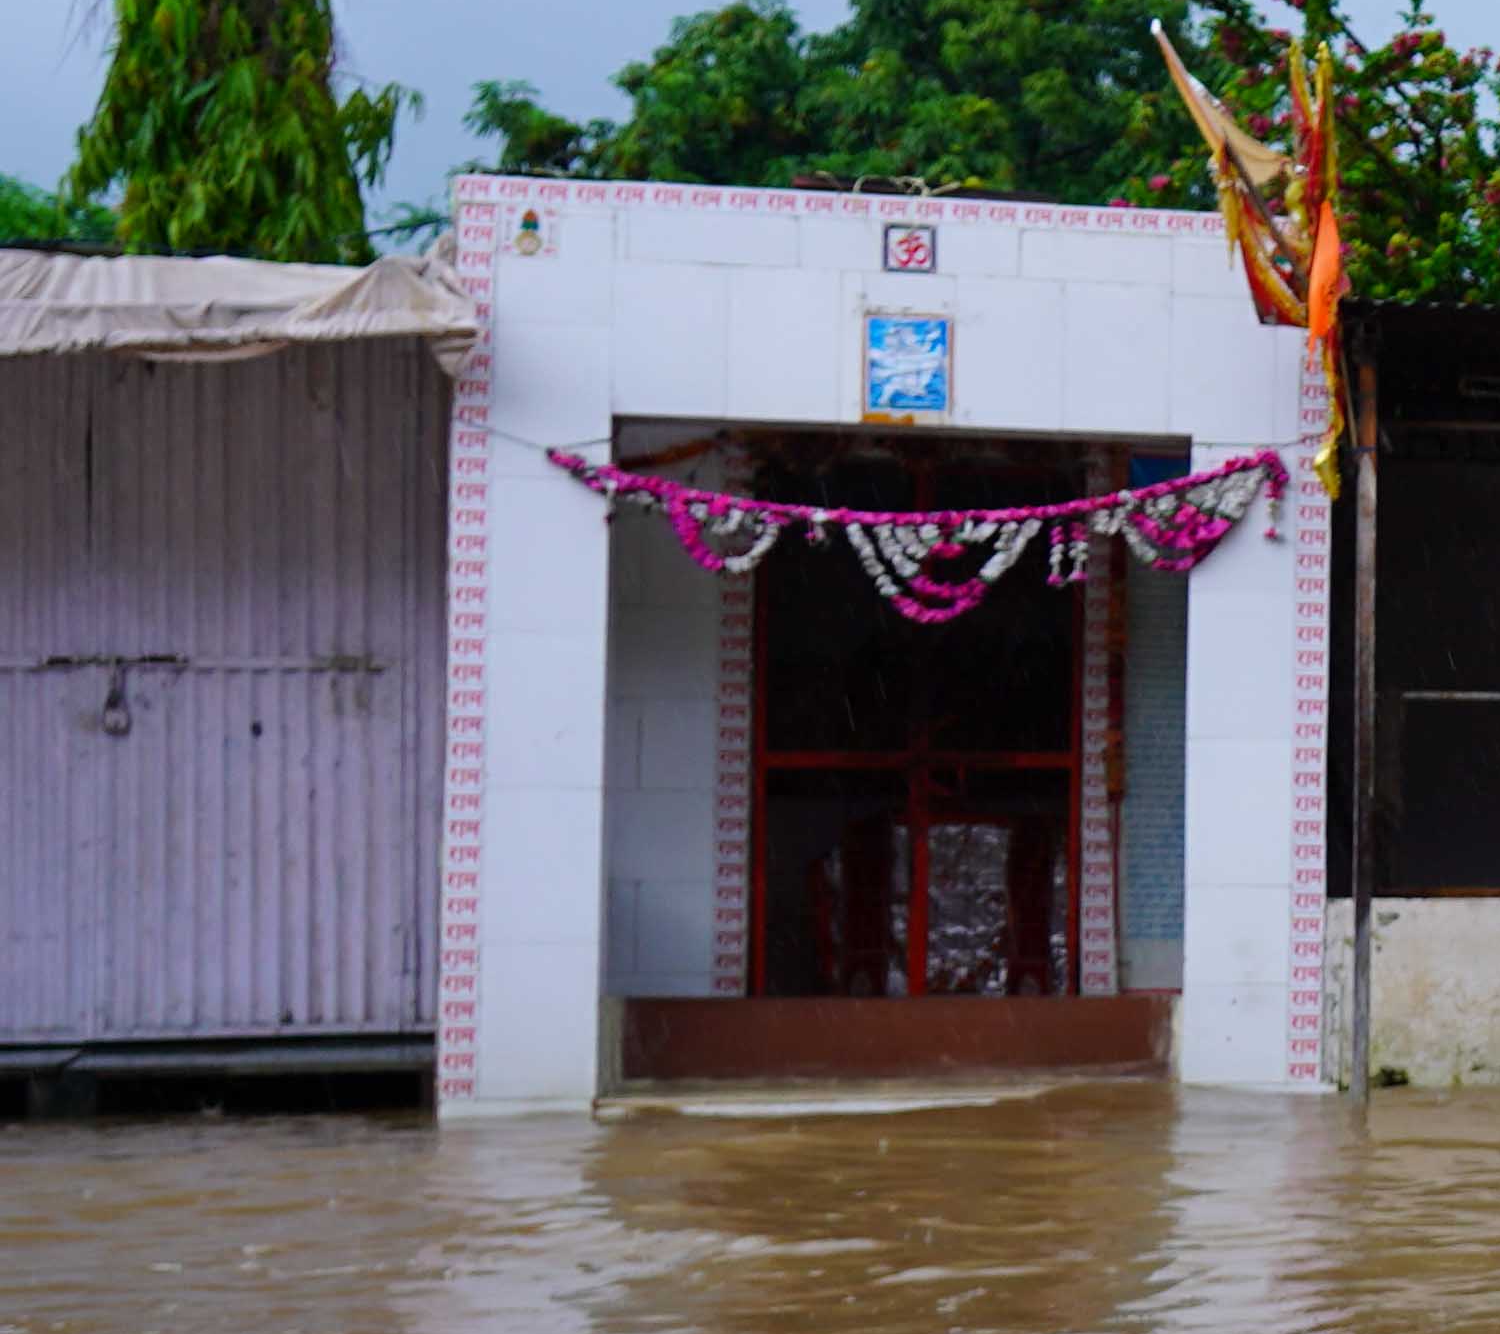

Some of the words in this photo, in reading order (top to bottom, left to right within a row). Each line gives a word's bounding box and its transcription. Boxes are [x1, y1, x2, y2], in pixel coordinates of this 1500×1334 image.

[465, 203, 492, 219] राम
[464, 224, 492, 241] राम
[463, 250, 490, 267] राम
[894, 233, 929, 267] ॐ
[459, 379, 487, 395] राम
[458, 405, 487, 422] राम
[458, 430, 486, 449] राम
[456, 456, 486, 475] राम
[457, 482, 486, 499] राम
[455, 508, 486, 526] राम
[1300, 505, 1326, 521] राम
[456, 534, 486, 553] राम
[1300, 528, 1325, 545] राम
[455, 559, 484, 577] राम
[1299, 553, 1324, 569] राम
[456, 585, 485, 602] राम
[1297, 578, 1325, 593] राम
[1298, 602, 1325, 616] राम
[454, 612, 484, 629] राम
[1296, 626, 1324, 642] राम
[454, 638, 483, 656] राम
[1297, 650, 1324, 666] राम
[453, 664, 482, 680] राम
[1296, 674, 1324, 689] राम
[453, 689, 483, 706] राम
[1298, 698, 1324, 715] राम
[453, 715, 481, 733] राम
[1295, 722, 1321, 738] राम
[453, 741, 481, 758] राम
[1295, 746, 1320, 763] राम
[450, 767, 480, 785] राम
[1294, 772, 1320, 786] राम
[451, 793, 480, 812] राम
[1295, 795, 1323, 811] राम
[449, 819, 480, 837] राम
[1293, 820, 1321, 836] राम
[449, 845, 480, 863] राम
[1294, 844, 1323, 859] राम
[448, 870, 477, 889] राम
[1295, 868, 1323, 884] राम
[448, 896, 477, 913] राम
[1294, 892, 1322, 909] राम
[447, 922, 476, 938] राम
[1292, 917, 1322, 933] राम
[446, 949, 475, 966] राम
[1294, 941, 1322, 957] राम
[1292, 965, 1321, 981] राम
[444, 974, 474, 992] राम
[1292, 989, 1318, 1005] राम
[444, 1000, 474, 1019] राम
[1291, 1014, 1318, 1030] राम
[444, 1026, 475, 1042] राम
[1291, 1038, 1318, 1054] राम
[444, 1052, 473, 1070] राम
[1290, 1062, 1316, 1079] राम
[443, 1078, 473, 1095] राम
